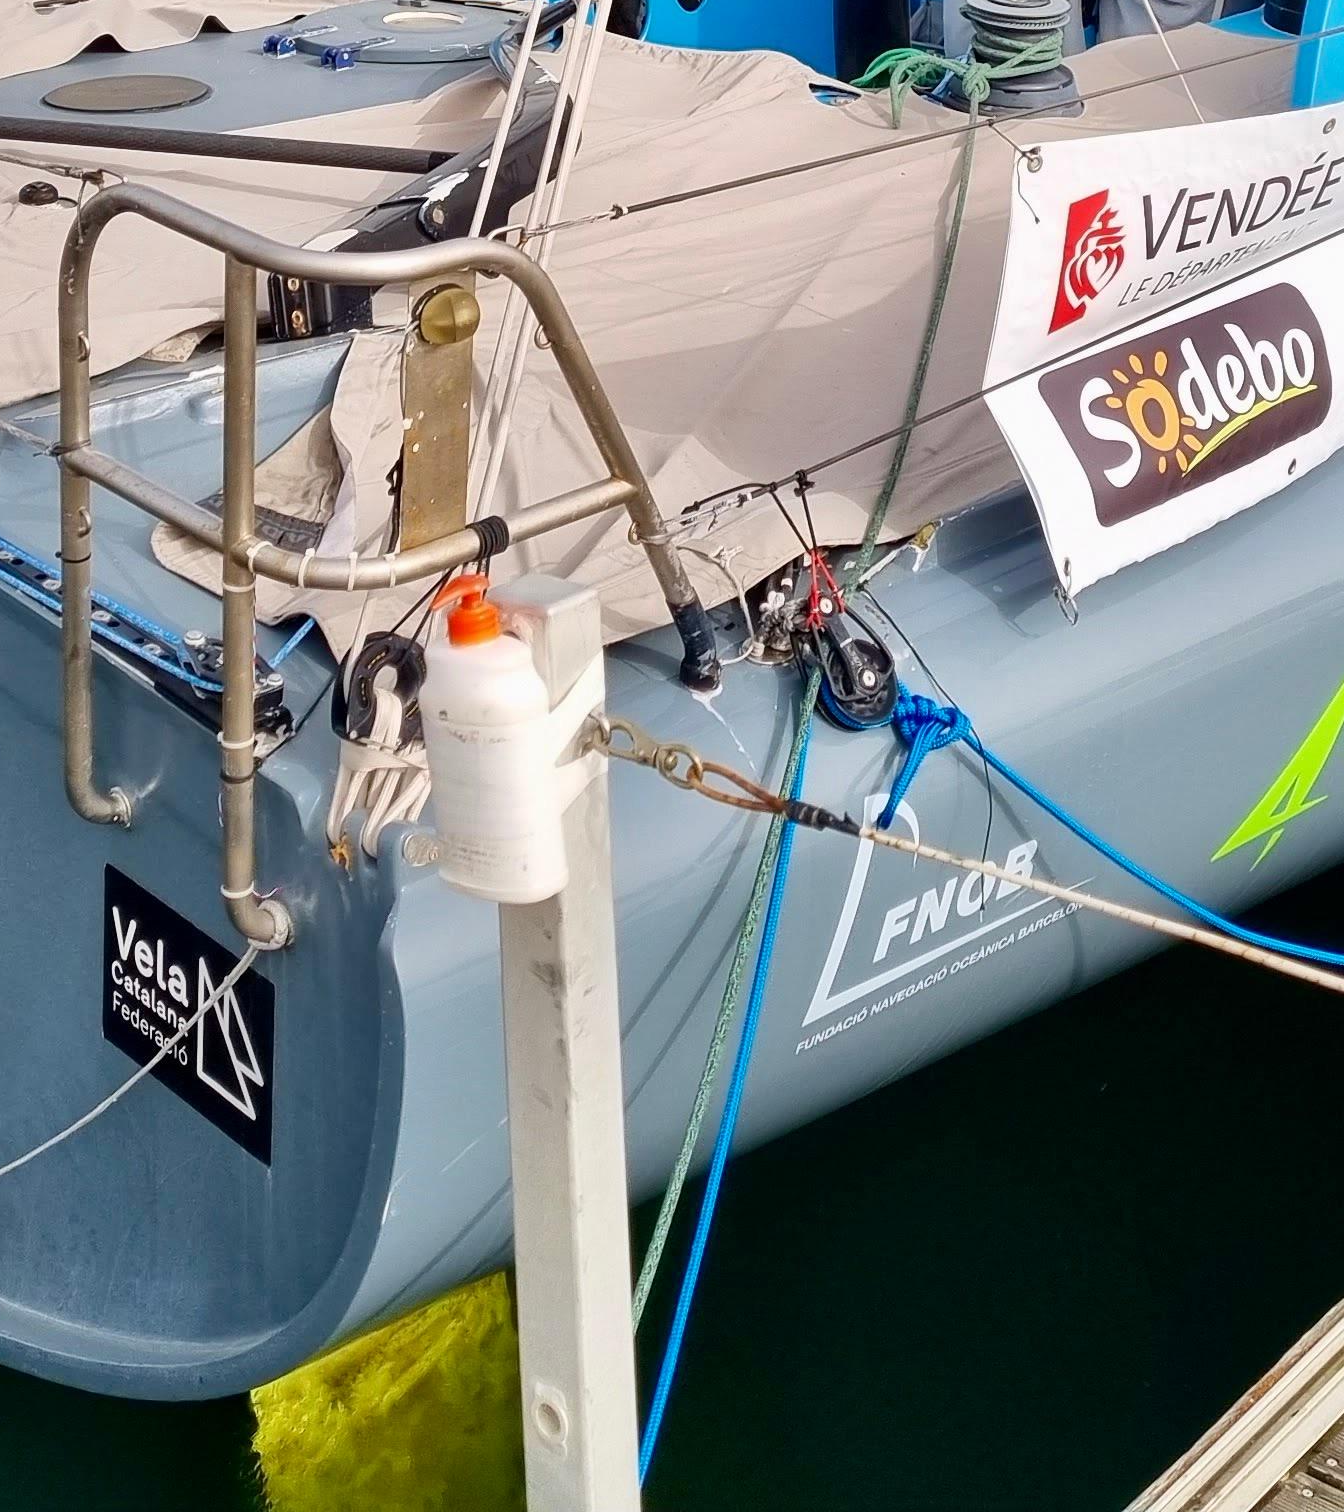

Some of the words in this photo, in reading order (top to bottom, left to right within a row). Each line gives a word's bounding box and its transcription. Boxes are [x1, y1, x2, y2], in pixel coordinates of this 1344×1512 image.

[1117, 277, 1153, 308] LE
[1079, 323, 1315, 488] Sodebo
[872, 839, 1038, 964] FNOB
[111, 960, 189, 1037] Catalana
[112, 905, 189, 1008] Vela
[795, 1007, 869, 1055] FUNDACIÓ
[869, 963, 948, 1017] NAVEGACIÓ
[949, 932, 1016, 975] OCEÀNICA
[1017, 895, 1092, 941] BARCELON
[112, 990, 188, 1066] Federació
